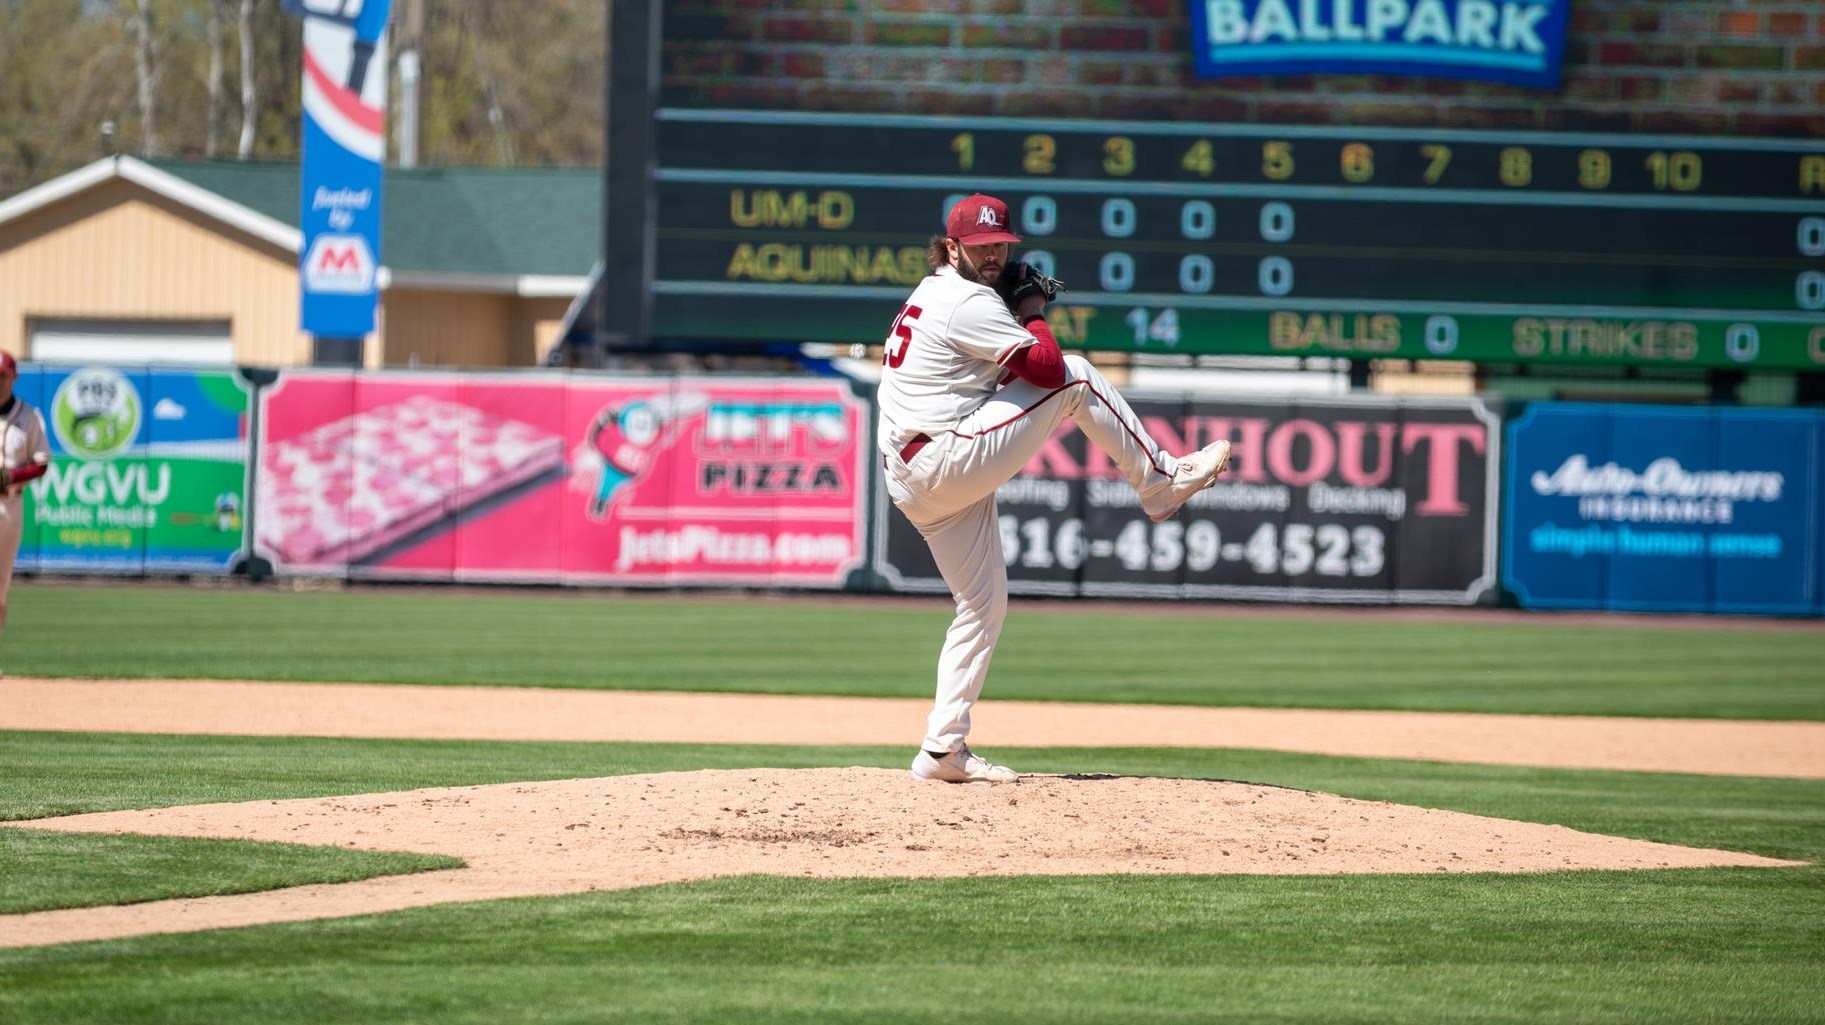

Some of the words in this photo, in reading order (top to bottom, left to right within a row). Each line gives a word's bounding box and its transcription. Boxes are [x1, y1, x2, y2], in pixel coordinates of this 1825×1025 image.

[1206, 0, 1548, 52] BALLPARK
[951, 133, 975, 171] 1
[1023, 133, 1057, 175] 2
[1102, 136, 1136, 176] 3
[1181, 139, 1214, 178] 4
[1262, 141, 1295, 181] 5
[1341, 142, 1374, 183] 6
[1421, 144, 1453, 184] 7
[1500, 147, 1533, 187] 8
[1578, 148, 1611, 190] 9
[1646, 151, 1701, 191] 10
[730, 188, 854, 229] UM-D
[1022, 195, 1057, 236] 0
[1101, 197, 1136, 238] 0
[1180, 199, 1216, 240] 0
[1260, 201, 1295, 242] 0
[727, 242, 928, 285] AQUINAS
[1100, 251, 1135, 292] 0
[1179, 254, 1215, 294] 0
[1258, 255, 1294, 296] 0
[1125, 306, 1181, 347] 14
[1269, 312, 1400, 350] BALLS
[1424, 316, 1459, 354] 0
[1512, 318, 1699, 359] STRIKES
[1725, 323, 1760, 362] 0
[29, 462, 171, 504] WGVU
[702, 463, 840, 490] PIZZA
[995, 476, 1069, 511] oofing
[1190, 482, 1290, 511] indows
[1578, 495, 1735, 524] INSURANCE
